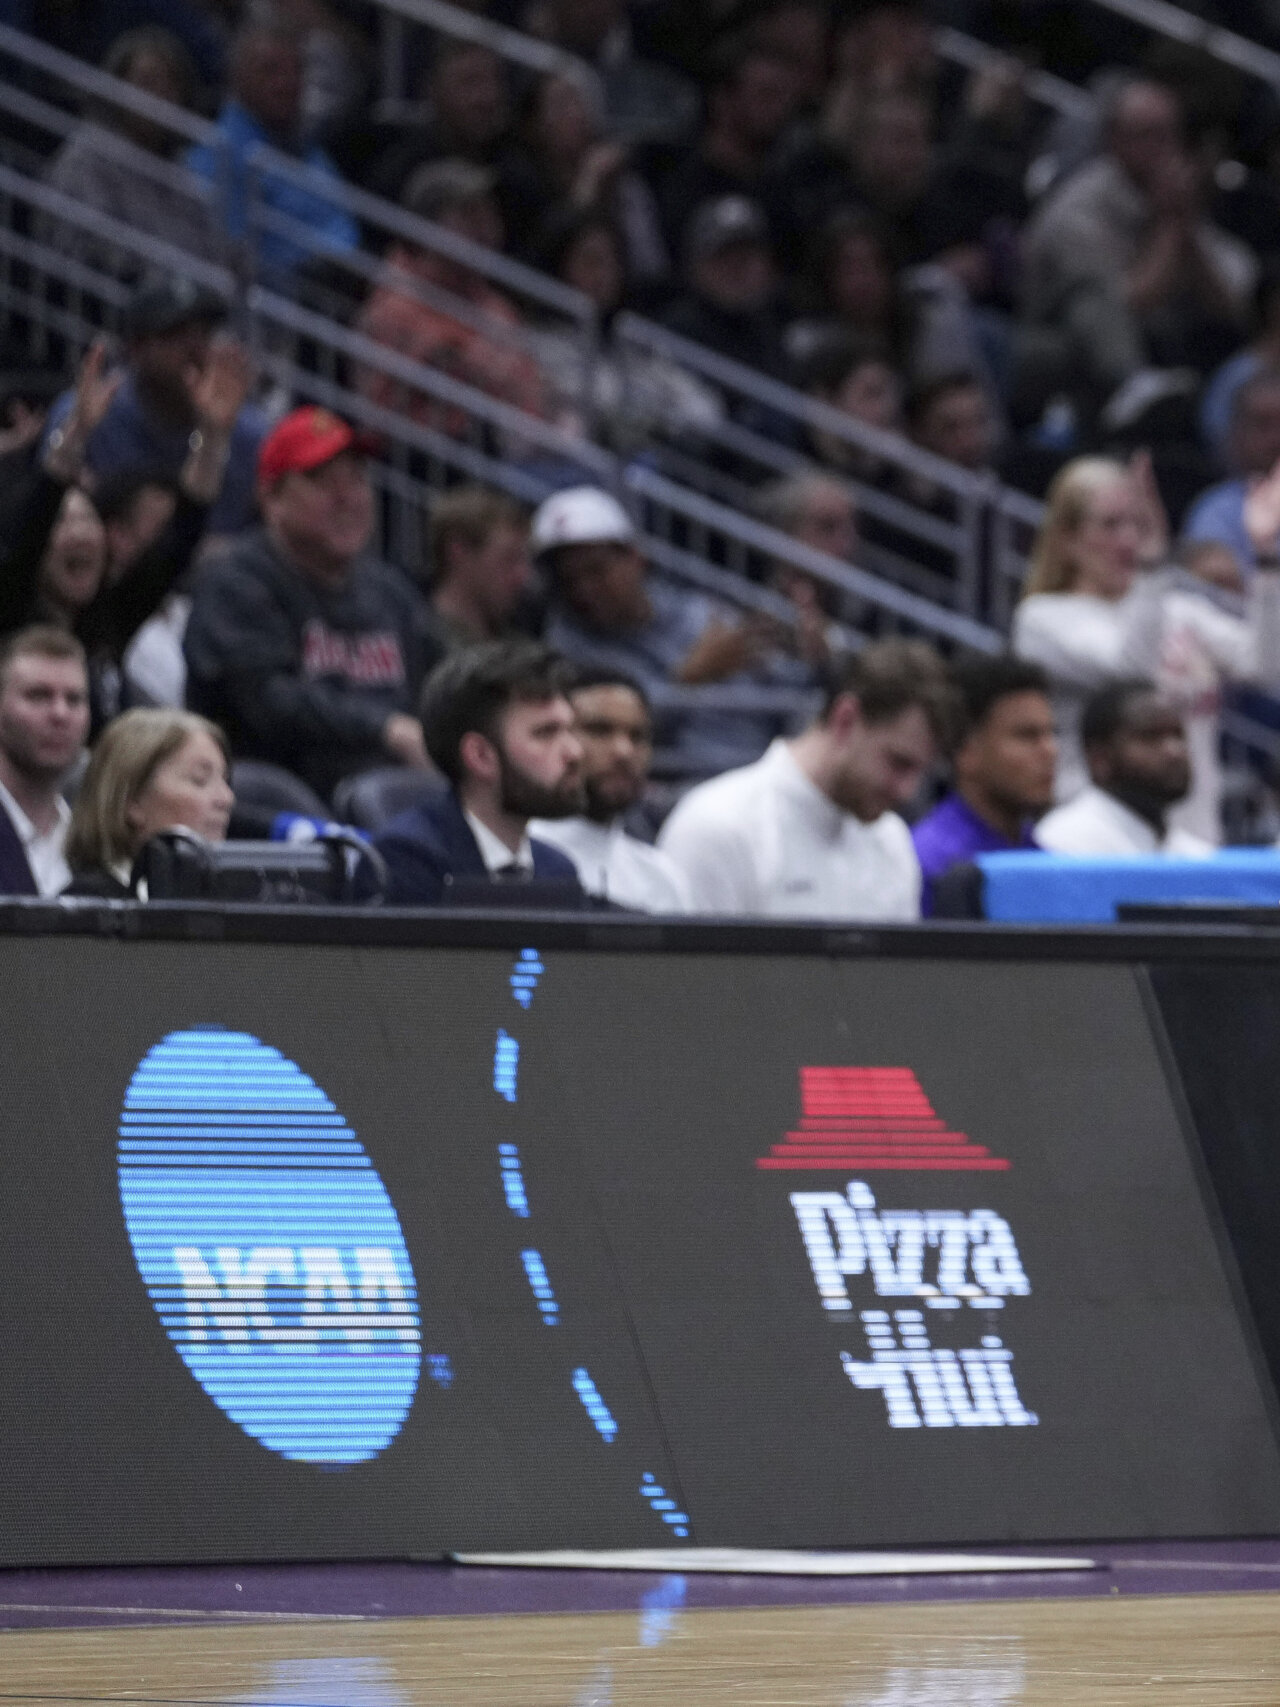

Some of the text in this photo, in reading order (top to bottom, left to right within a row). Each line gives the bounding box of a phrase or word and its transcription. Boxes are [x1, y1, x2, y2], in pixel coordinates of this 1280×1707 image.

[172, 1247, 422, 1355] NCAA
[788, 1179, 1031, 1310] Pizza
[840, 1310, 1040, 1428] Hut
